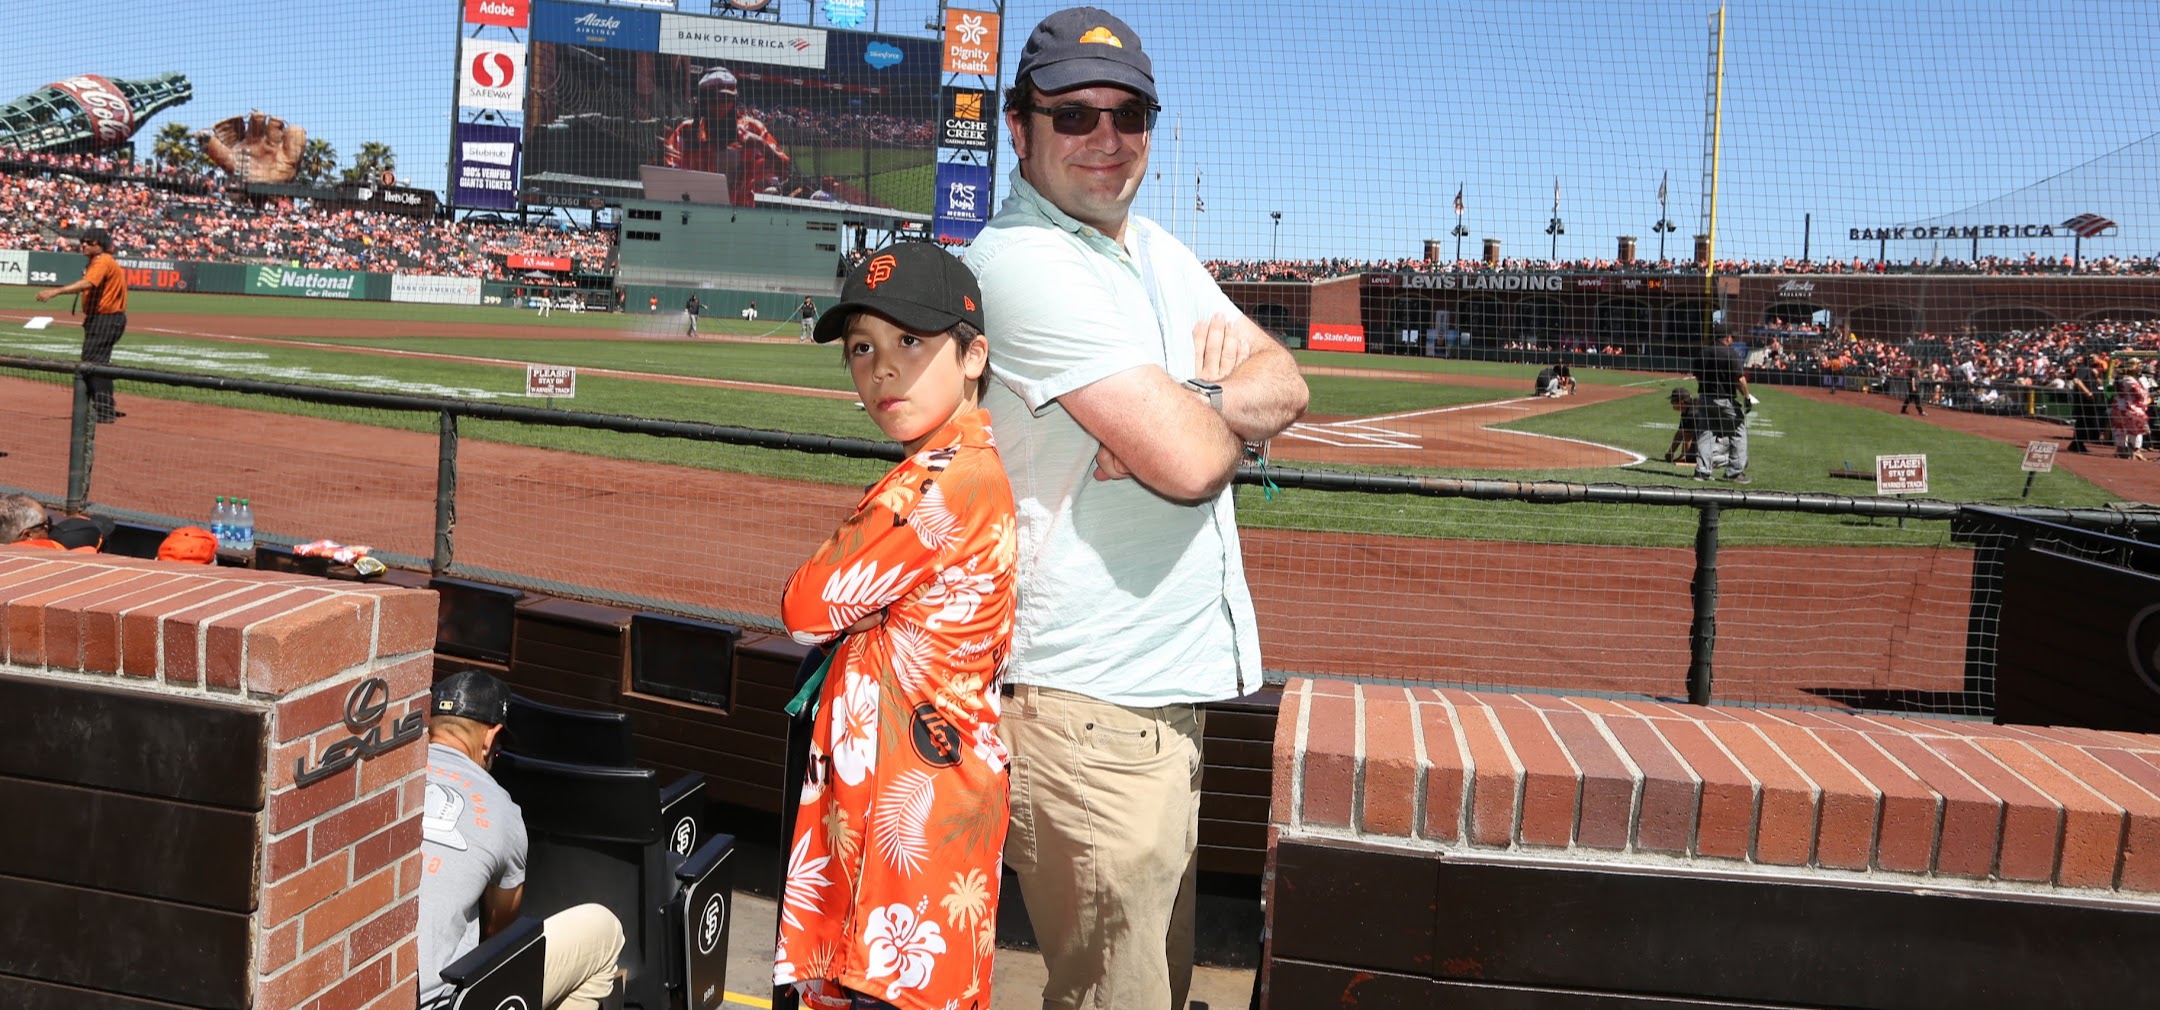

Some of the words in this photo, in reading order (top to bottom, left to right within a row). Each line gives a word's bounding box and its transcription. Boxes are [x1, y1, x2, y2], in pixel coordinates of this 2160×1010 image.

[479, 1, 515, 16] Adobe
[574, 12, 620, 29] Alaska
[576, 27, 616, 36] AIRLINES
[678, 31, 710, 42] BANK
[714, 34, 729, 43] OF
[731, 37, 785, 49] AMERICA
[951, 46, 990, 62] Dignity
[952, 59, 988, 72] Health
[470, 88, 512, 99] SAFEWAY
[946, 119, 987, 131] CACHE
[946, 129, 985, 140] CREEK
[469, 147, 506, 158] StubHub
[462, 167, 481, 177] 100%
[482, 168, 511, 180] VERIFIED
[459, 177, 484, 189] GIANTS
[485, 179, 512, 190] TICKETS
[401, 193, 421, 205] Coffee
[1850, 227, 1905, 240] BANK
[1913, 227, 1940, 239] OF
[1946, 225, 2053, 239] AMERICA
[138, 260, 174, 270] BASEBALL
[30, 271, 57, 282] 354
[281, 271, 354, 290] National
[1462, 275, 1563, 290] LANDING
[306, 289, 320, 297] Car
[322, 290, 349, 298] Rental
[484, 296, 502, 305] 399
[1883, 459, 1920, 469] PLEASE!
[1888, 469, 1905, 477] STAY
[946, 634, 994, 660] Alaska
[294, 709, 424, 789] LEXUS
